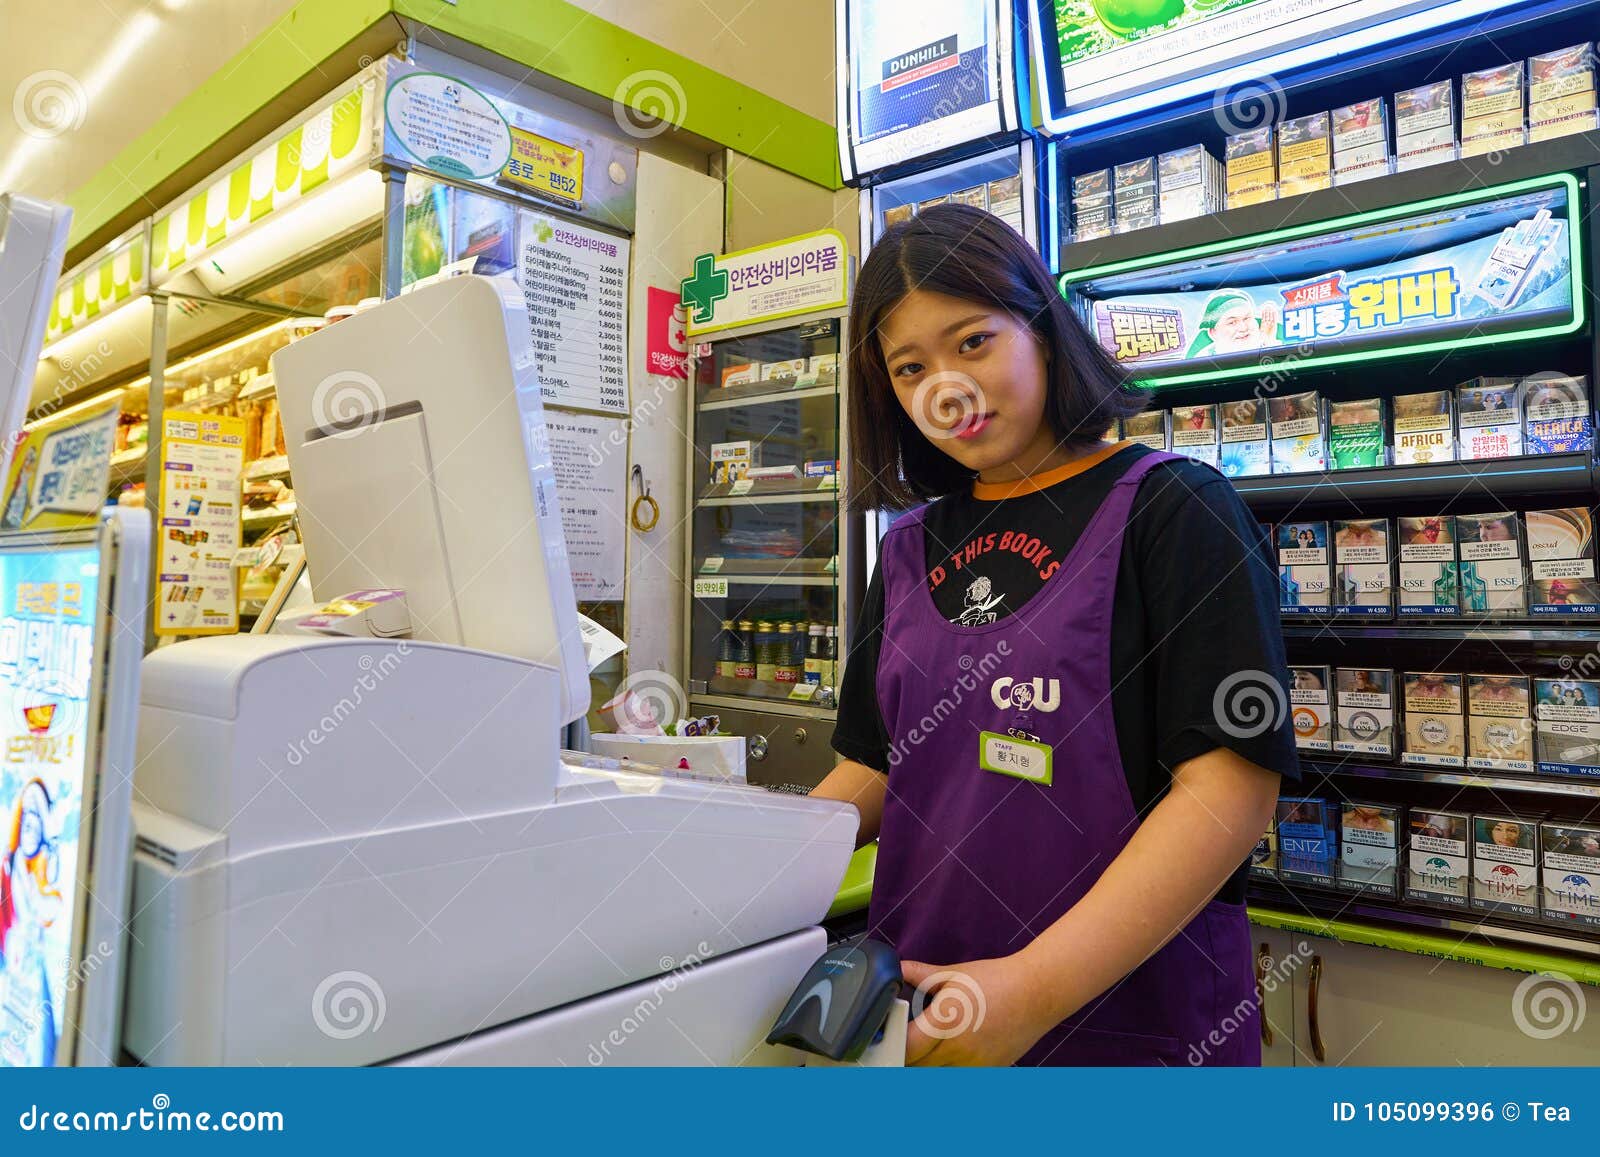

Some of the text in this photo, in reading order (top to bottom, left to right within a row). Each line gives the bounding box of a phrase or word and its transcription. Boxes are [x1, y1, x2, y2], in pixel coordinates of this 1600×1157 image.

[890, 43, 948, 73] DUNHILL
[509, 157, 534, 180] 종로
[549, 171, 576, 194] 편52
[555, 229, 618, 257] 안전상비의약품
[600, 264, 623, 277] 2,600원
[730, 245, 839, 292] 안전상비의약품
[1293, 281, 1333, 301] 신제품
[1350, 266, 1460, 326] 휘바
[1286, 302, 1345, 338] 레종
[1534, 419, 1583, 436] AFRICA
[1401, 433, 1445, 448] AFRICA
[951, 532, 996, 570] THIS
[998, 530, 1060, 581] BOOKS
[1305, 581, 1325, 590] ESSE
[1365, 580, 1385, 589] ESSE
[1404, 579, 1426, 588] ESSE
[1494, 577, 1518, 586] ESSE
[991, 676, 1061, 713] CU
[1551, 723, 1589, 734] EDGE
[1283, 838, 1323, 854] ENTZ
[1418, 871, 1458, 889] TIME
[1485, 879, 1527, 897] TIME
[1555, 889, 1600, 908] TIME
